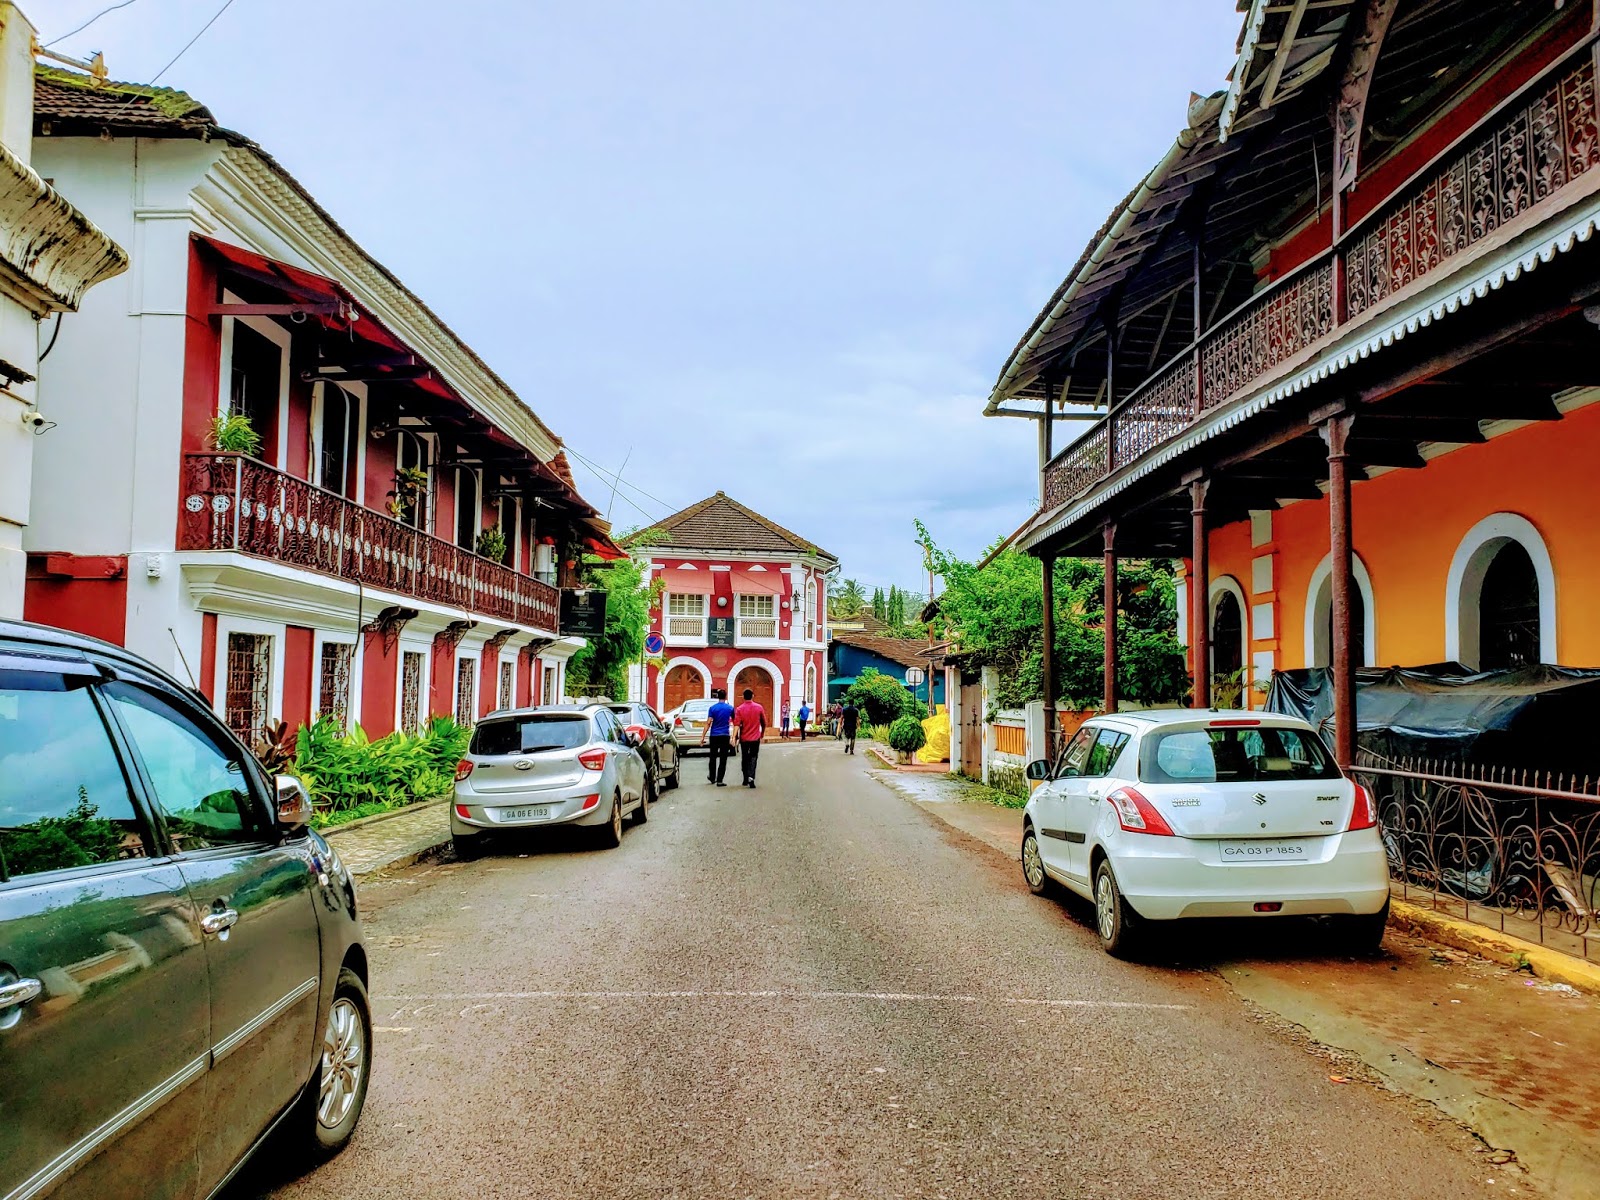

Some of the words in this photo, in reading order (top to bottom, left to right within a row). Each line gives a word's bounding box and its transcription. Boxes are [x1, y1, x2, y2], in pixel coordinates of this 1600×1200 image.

[533, 808, 548, 816] 1193
[1248, 847, 1262, 855] 03
[1277, 846, 1303, 854] 1853
